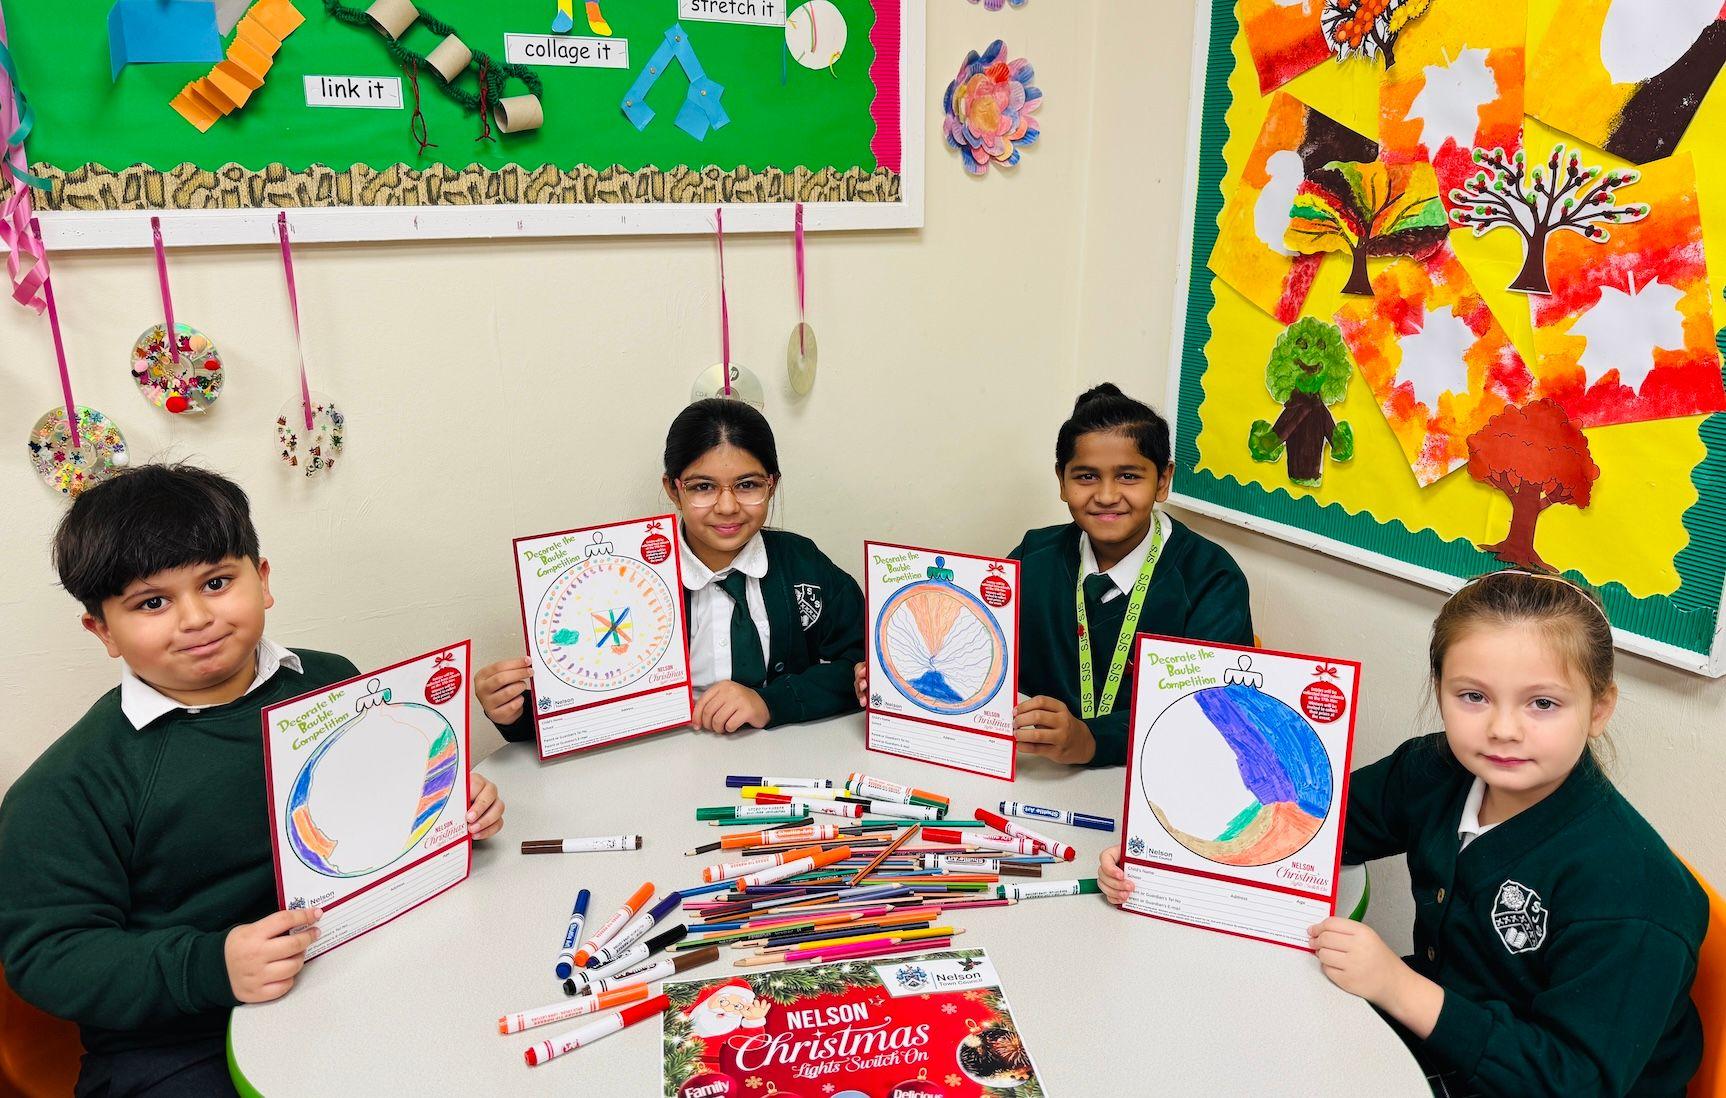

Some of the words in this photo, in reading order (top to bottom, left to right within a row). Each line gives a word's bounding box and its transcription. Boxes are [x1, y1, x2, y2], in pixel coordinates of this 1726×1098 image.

[691, 0, 756, 16] stretch
[762, 0, 774, 17] it
[525, 38, 590, 64] collage
[598, 42, 610, 60] it
[321, 77, 360, 98] link
[368, 80, 384, 98] it
[524, 542, 562, 561] Decorate
[562, 536, 576, 546] the
[540, 550, 568, 566] Bauble
[1146, 544, 1158, 564] SJS
[537, 555, 580, 577] Competition
[873, 554, 906, 566] Decorate
[908, 552, 920, 560] the
[886, 562, 910, 574] Bauble
[882, 572, 922, 583] Competition
[1136, 573, 1150, 592] SJS
[1126, 602, 1140, 622] SJS
[1117, 632, 1131, 652] SJS
[1147, 652, 1197, 666] Decorate
[1198, 649, 1216, 660] the
[648, 670, 684, 684] Christmas
[658, 664, 674, 672] NELSON
[1081, 662, 1091, 682] SJS
[1108, 662, 1123, 683] SJS
[1166, 664, 1201, 676] Bauble
[1158, 676, 1216, 690] Competition
[276, 702, 328, 733] Decorate
[328, 690, 346, 704] the
[1083, 692, 1092, 713] SJS
[1100, 692, 1114, 713] SJS
[292, 712, 349, 750] Competition
[298, 710, 334, 734] Bauble
[973, 714, 1010, 728] Christmas
[435, 820, 454, 833] NELSON
[424, 824, 465, 850] Christmas
[1148, 848, 1173, 858] Nelson
[1276, 864, 1329, 886] Christmas
[1292, 861, 1314, 872] NELSON
[310, 890, 335, 905] Nelson
[936, 972, 981, 981] Nelson
[787, 1002, 868, 1030] NELSON
[728, 1017, 930, 1072] Christmas
[792, 1058, 848, 1079] Lights
[845, 1051, 900, 1072] Switch
[900, 1048, 929, 1065] On
[684, 1080, 730, 1098] Family
